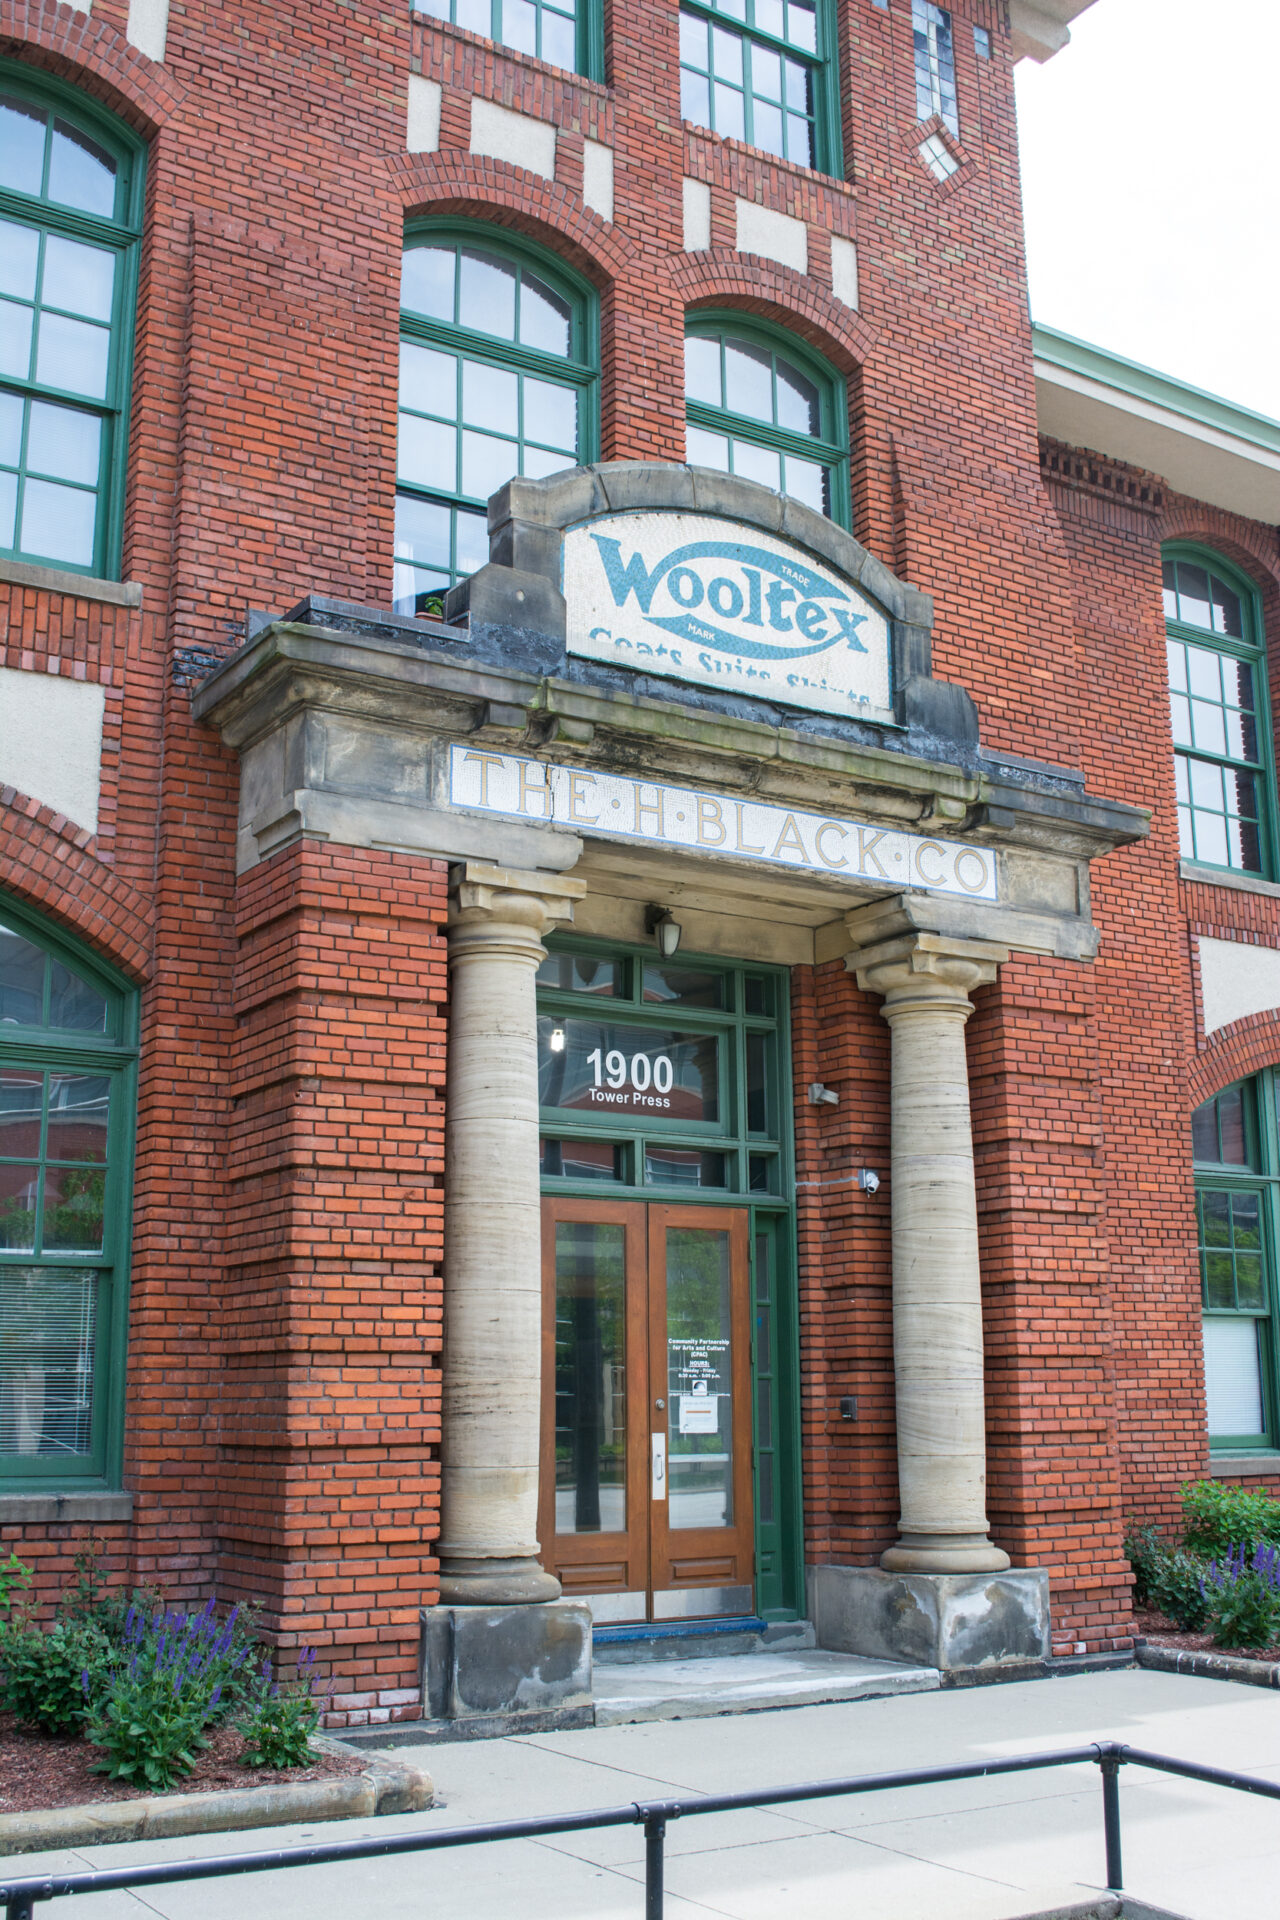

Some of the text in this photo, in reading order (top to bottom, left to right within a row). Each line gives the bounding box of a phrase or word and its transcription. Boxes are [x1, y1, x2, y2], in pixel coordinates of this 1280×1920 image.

[781, 565, 810, 588] TRADE
[589, 534, 869, 655] Wooltex
[687, 623, 717, 642] MARK
[586, 1048, 673, 1093] 1900
[588, 1088, 671, 1108] Tower Press
